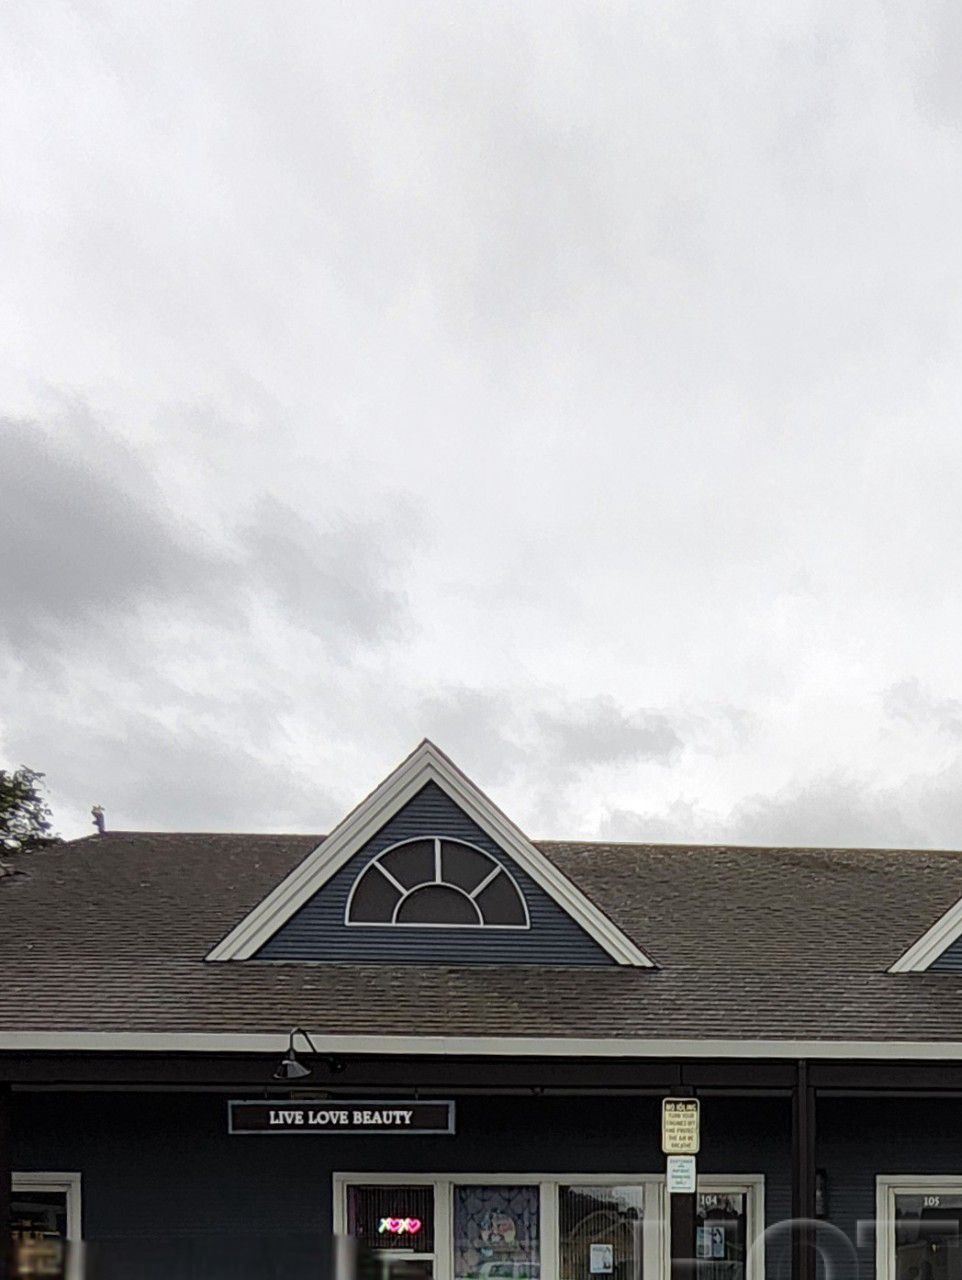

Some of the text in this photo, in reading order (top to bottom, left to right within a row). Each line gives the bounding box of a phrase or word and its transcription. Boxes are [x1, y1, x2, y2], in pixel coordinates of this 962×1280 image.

[269, 1110, 414, 1125] LIVE LOVE BEAUTY
[701, 1195, 718, 1206] 104
[924, 1196, 940, 1207] 105
